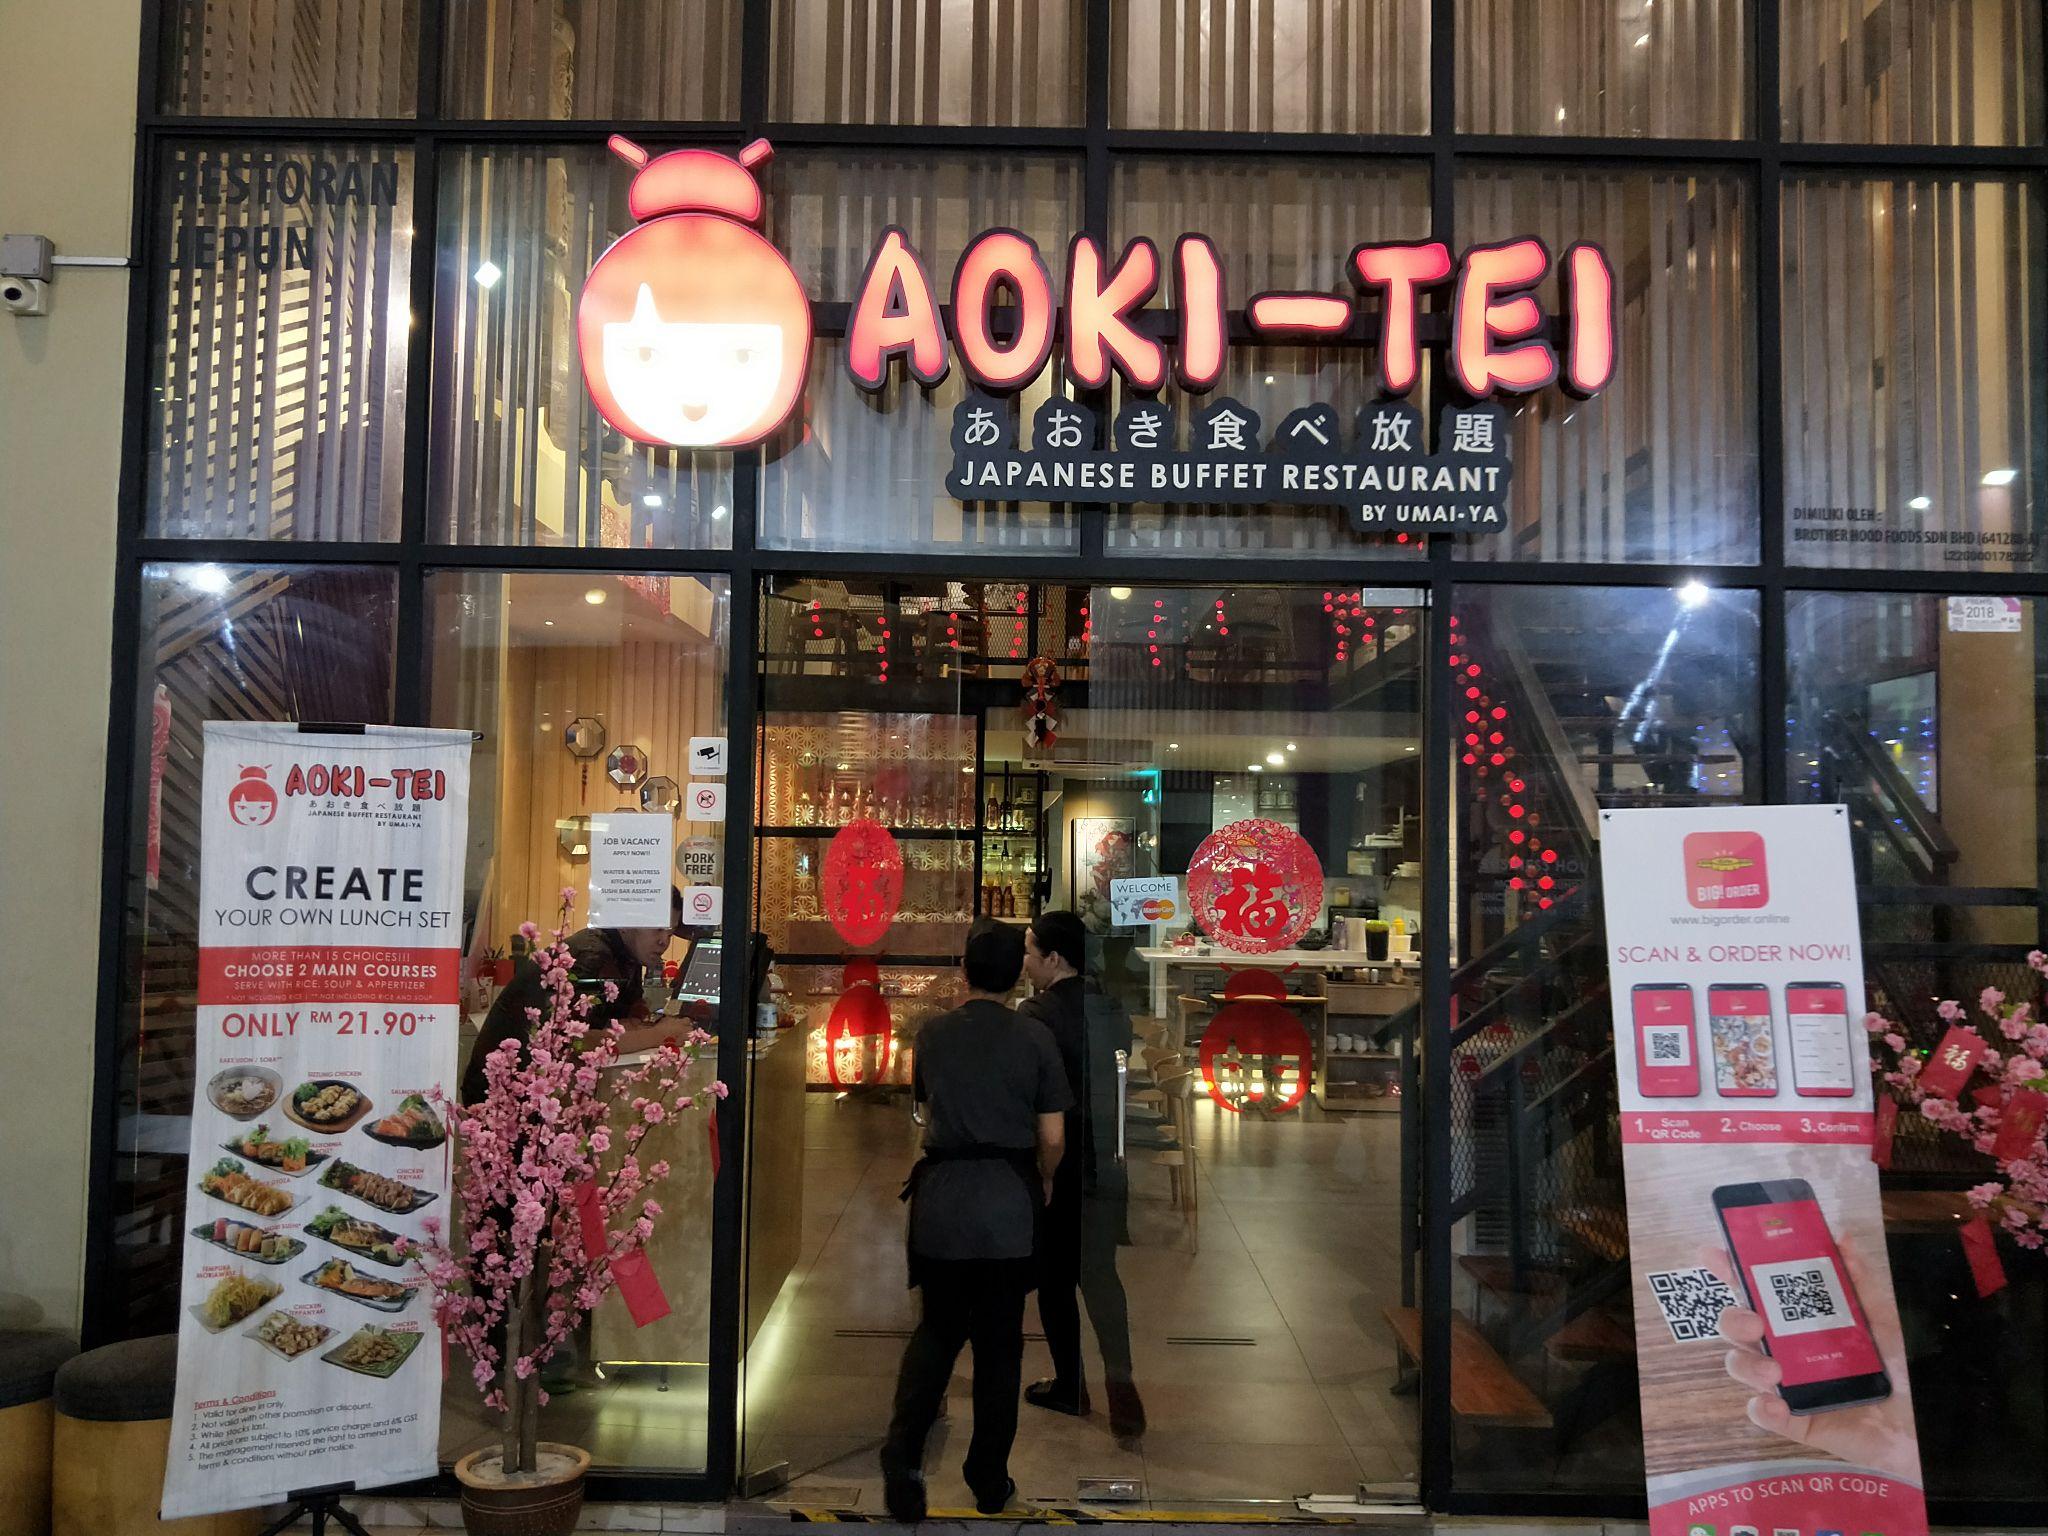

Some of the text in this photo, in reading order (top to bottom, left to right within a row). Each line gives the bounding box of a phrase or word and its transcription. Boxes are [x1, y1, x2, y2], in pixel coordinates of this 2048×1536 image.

[171, 160, 398, 206] RESTORAN
[169, 226, 314, 270] JEPUN
[845, 225, 1616, 396] AOKI-TEI
[964, 407, 1495, 453] あおき食べ放題
[960, 461, 1500, 492] JAPANESE BUFFET RESTAURANT
[1362, 504, 1499, 523] BY UMAI-YA
[1794, 529, 1848, 541] BROTHER
[1850, 530, 1882, 542] HOOD
[1885, 530, 1922, 543] FOODS
[1925, 531, 1947, 544] SDN
[1951, 531, 1975, 544] BHD
[1966, 606, 1995, 618] 2018
[285, 763, 446, 801] AOKI-TEI
[309, 800, 421, 812] あおき食べ放題
[375, 812, 421, 820] RESTAURANT
[685, 853, 715, 863] PORK
[686, 865, 713, 874] FREE
[246, 865, 424, 902] CREATE
[1117, 883, 1172, 893] WELCOME
[1214, 863, 1289, 938] 福
[1697, 884, 1760, 901] BIG! ORDER
[215, 908, 451, 929] YOUR OWN LUNCH SET
[1671, 914, 1790, 926] www.bigorder.online
[252, 951, 410, 962] MORE THAN 15 CHOICES!!!
[1618, 944, 1851, 963] SCAN & ORDER NOW!
[224, 963, 437, 978] CHOOSE 2 MAIN COURSES
[235, 980, 264, 990] SERVE
[267, 980, 293, 989] WITH
[324, 980, 352, 989] SOUP
[222, 1011, 300, 1038] ONLY
[310, 1011, 333, 1024] RM
[1635, 1118, 1689, 1134] 1. Scan
[1651, 1129, 1701, 1139] QR Code
[1720, 1118, 1782, 1133] 2. Choose
[1801, 1118, 1859, 1133] 3. Confirm
[201, 1421, 216, 1429] Not
[219, 1418, 239, 1427] valid
[241, 1414, 257, 1423] with
[258, 1411, 280, 1420] other
[282, 1406, 324, 1420] promotion
[326, 1405, 335, 1413] or
[203, 1410, 223, 1418] Valid
[239, 1406, 256, 1414] dine
[200, 1441, 210, 1449] All
[212, 1439, 233, 1450] price
[235, 1436, 249, 1444] are
[250, 1432, 281, 1443] subject
[295, 1428, 310, 1438] 10%
[312, 1425, 340, 1435] service
[341, 1421, 371, 1431] charge
[373, 1418, 389, 1427] and
[201, 1430, 223, 1439] While
[227, 1426, 249, 1436] stocks
[199, 1452, 214, 1460] The
[215, 1443, 273, 1458] management
[275, 1438, 310, 1449] reserved
[313, 1436, 325, 1445] the
[327, 1433, 346, 1443] right
[357, 1428, 387, 1439] amend
[389, 1426, 402, 1435] the
[231, 1452, 274, 1465] conditions
[277, 1449, 307, 1459] without
[308, 1446, 326, 1457] prior
[1688, 1477, 1889, 1516] APPS TO SCAN QR CODE
